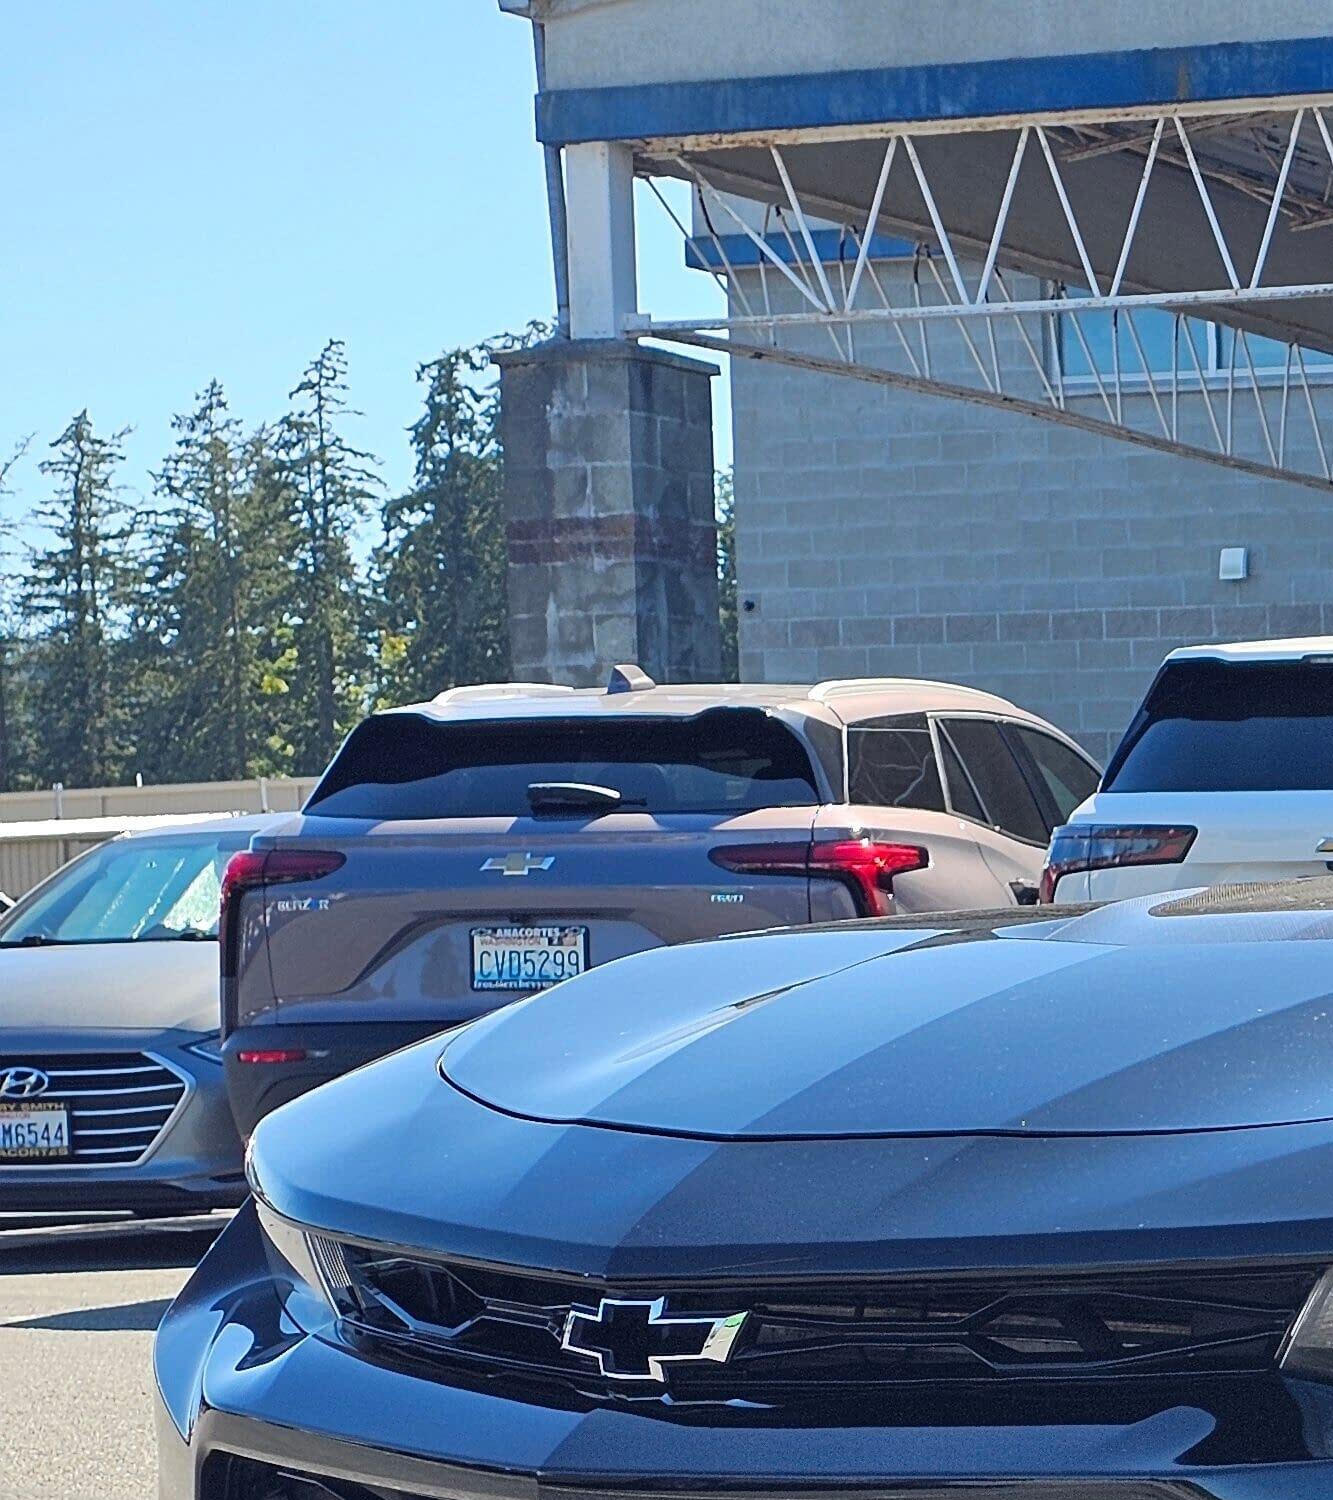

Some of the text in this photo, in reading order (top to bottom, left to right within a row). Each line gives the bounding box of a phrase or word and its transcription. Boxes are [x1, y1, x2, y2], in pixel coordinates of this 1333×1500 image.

[496, 928, 560, 937] ANACORTES
[480, 950, 580, 978] CVD5299
[21, 1103, 64, 1111] SMITH
